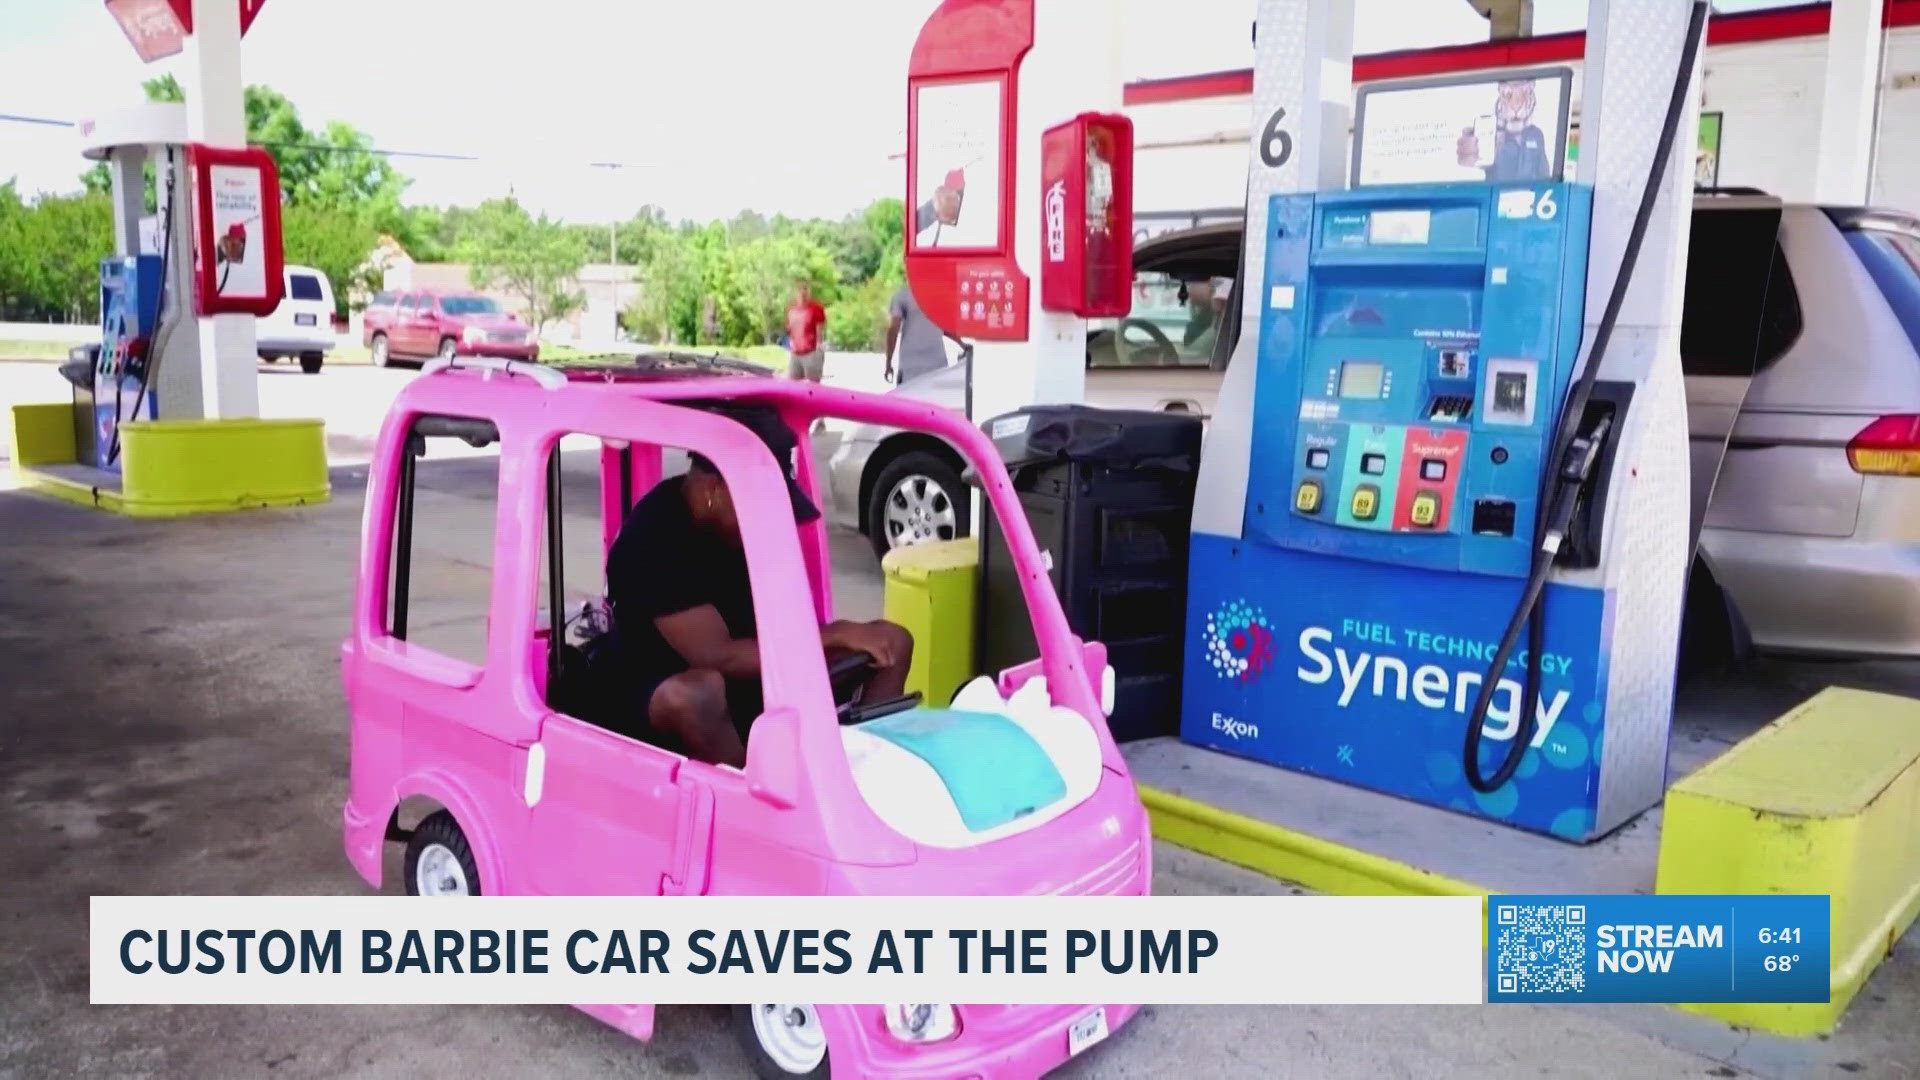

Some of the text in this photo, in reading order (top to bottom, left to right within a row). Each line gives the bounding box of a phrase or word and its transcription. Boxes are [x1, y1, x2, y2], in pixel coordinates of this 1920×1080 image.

[1259, 106, 1293, 169] 6
[1536, 188, 1557, 220] 6
[1051, 203, 1062, 254] FIRE
[1358, 499, 1370, 508] 89
[1416, 506, 1429, 516] 93
[1343, 618, 1396, 645] FUEL
[1297, 626, 1570, 748] Synergy
[1212, 713, 1258, 740] Exxon
